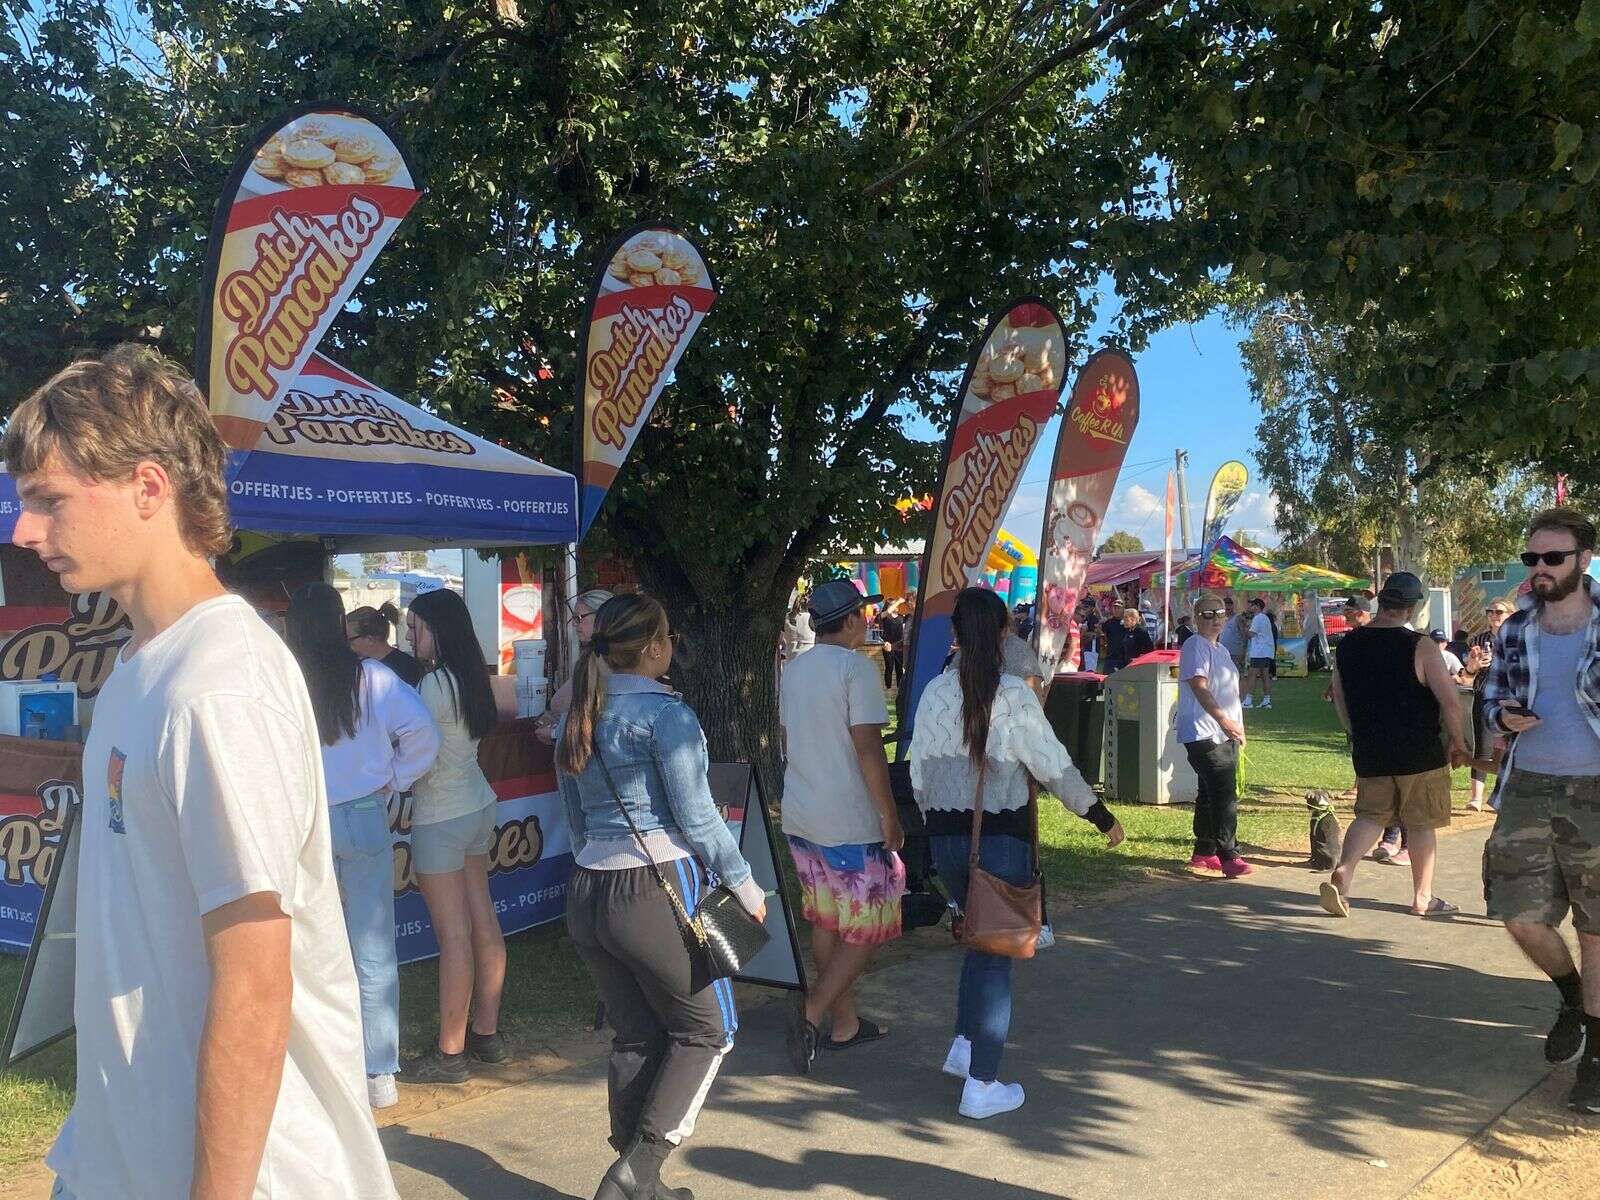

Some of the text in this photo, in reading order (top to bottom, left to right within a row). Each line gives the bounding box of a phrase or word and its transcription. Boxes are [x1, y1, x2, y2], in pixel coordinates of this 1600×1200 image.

[221, 208, 313, 332] Dutch
[227, 195, 384, 398] Pancakes
[590, 303, 649, 397] Dutch
[593, 294, 693, 449] Pancakes
[266, 411, 475, 454] Pancakes
[281, 390, 402, 419] Dutch
[1071, 406, 1100, 433] Coffee
[231, 481, 313, 500] OFFERTJES
[327, 489, 412, 505] POFFERTJES
[426, 492, 494, 511] POFFERTJES
[504, 500, 569, 514] POFFERTJES
[942, 413, 1036, 589] Pancakes
[944, 429, 1000, 538] Dutch
[519, 883, 568, 907] POFFERT
